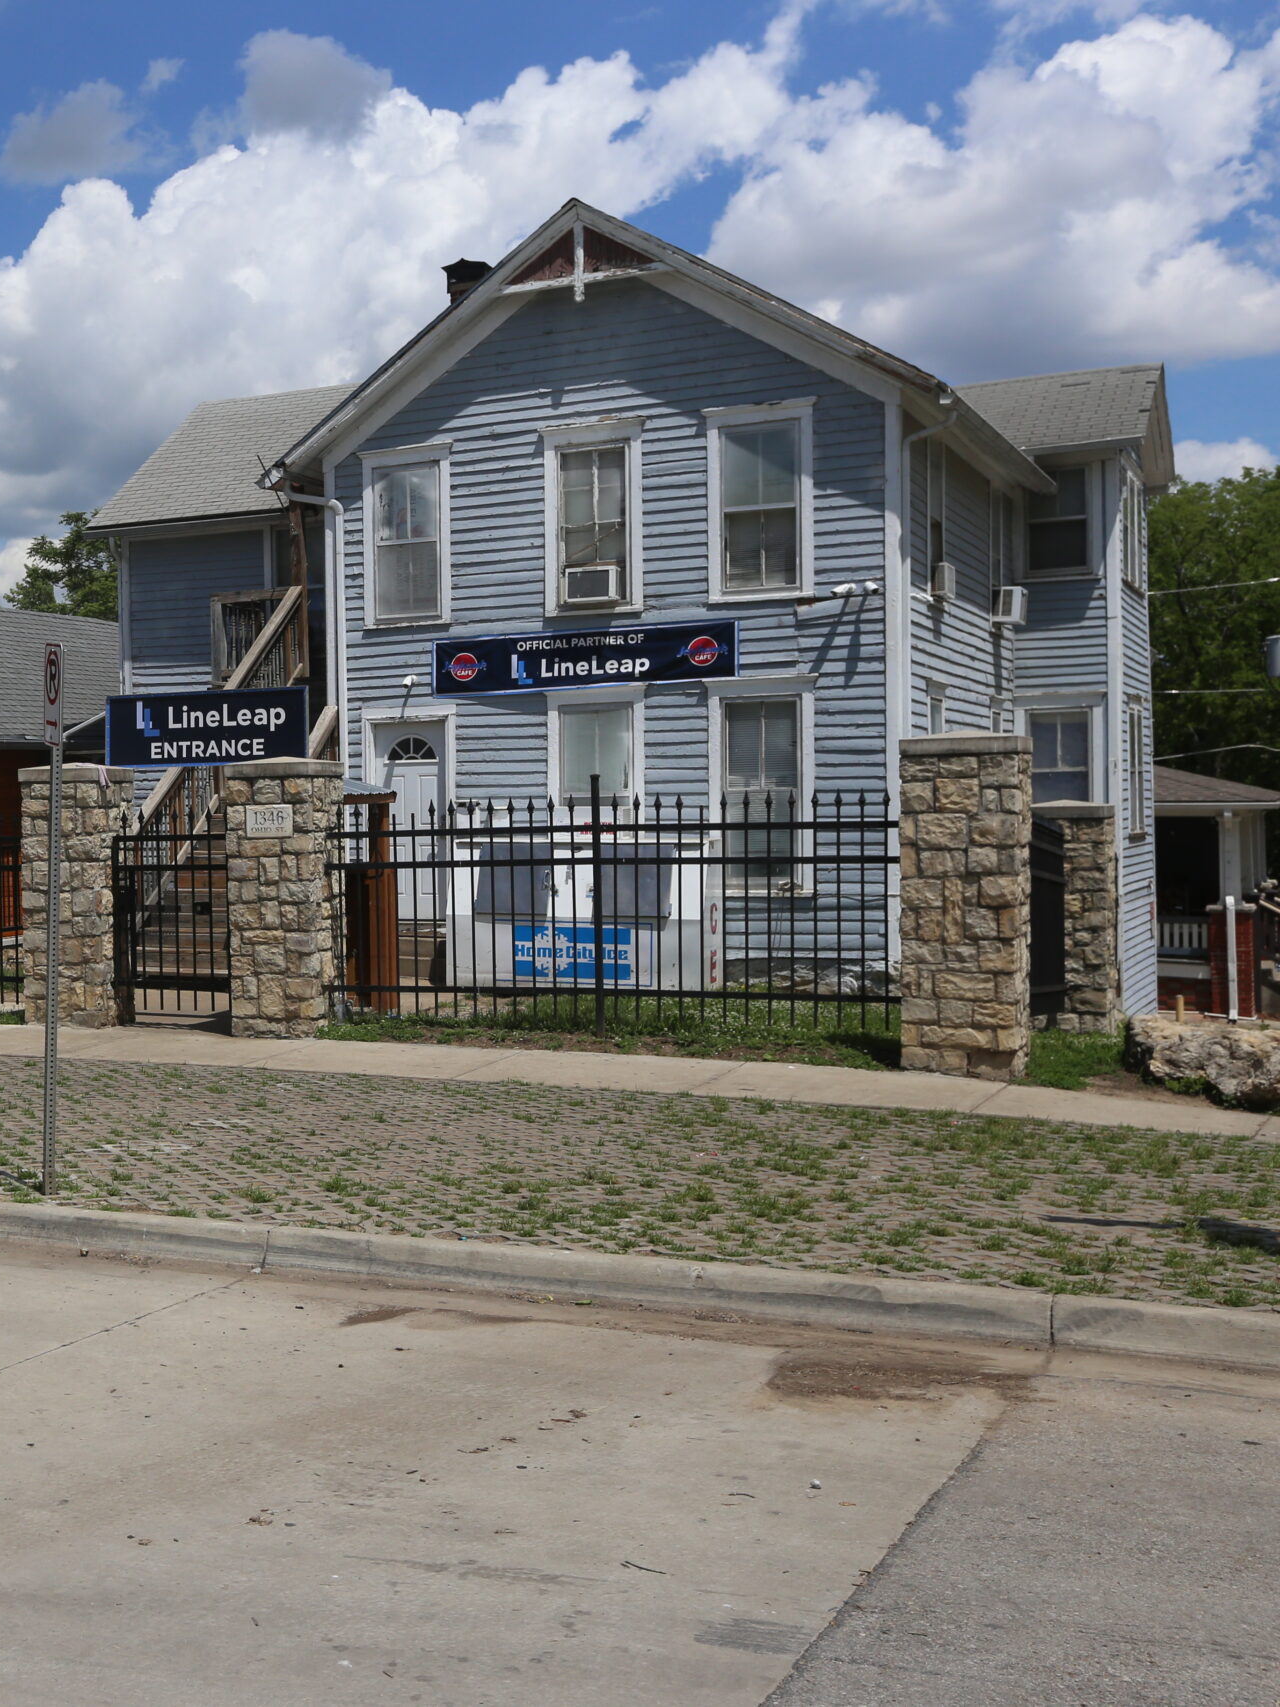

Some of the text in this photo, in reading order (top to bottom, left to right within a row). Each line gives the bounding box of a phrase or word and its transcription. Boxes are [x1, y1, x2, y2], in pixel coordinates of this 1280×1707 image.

[517, 634, 644, 651] OFFICIAL PARTNER OF
[541, 655, 650, 678] LineLeap
[168, 704, 286, 731] LineLeap
[151, 739, 265, 759] ENTRANCE
[253, 811, 284, 825] 1346
[515, 944, 563, 959] Home
